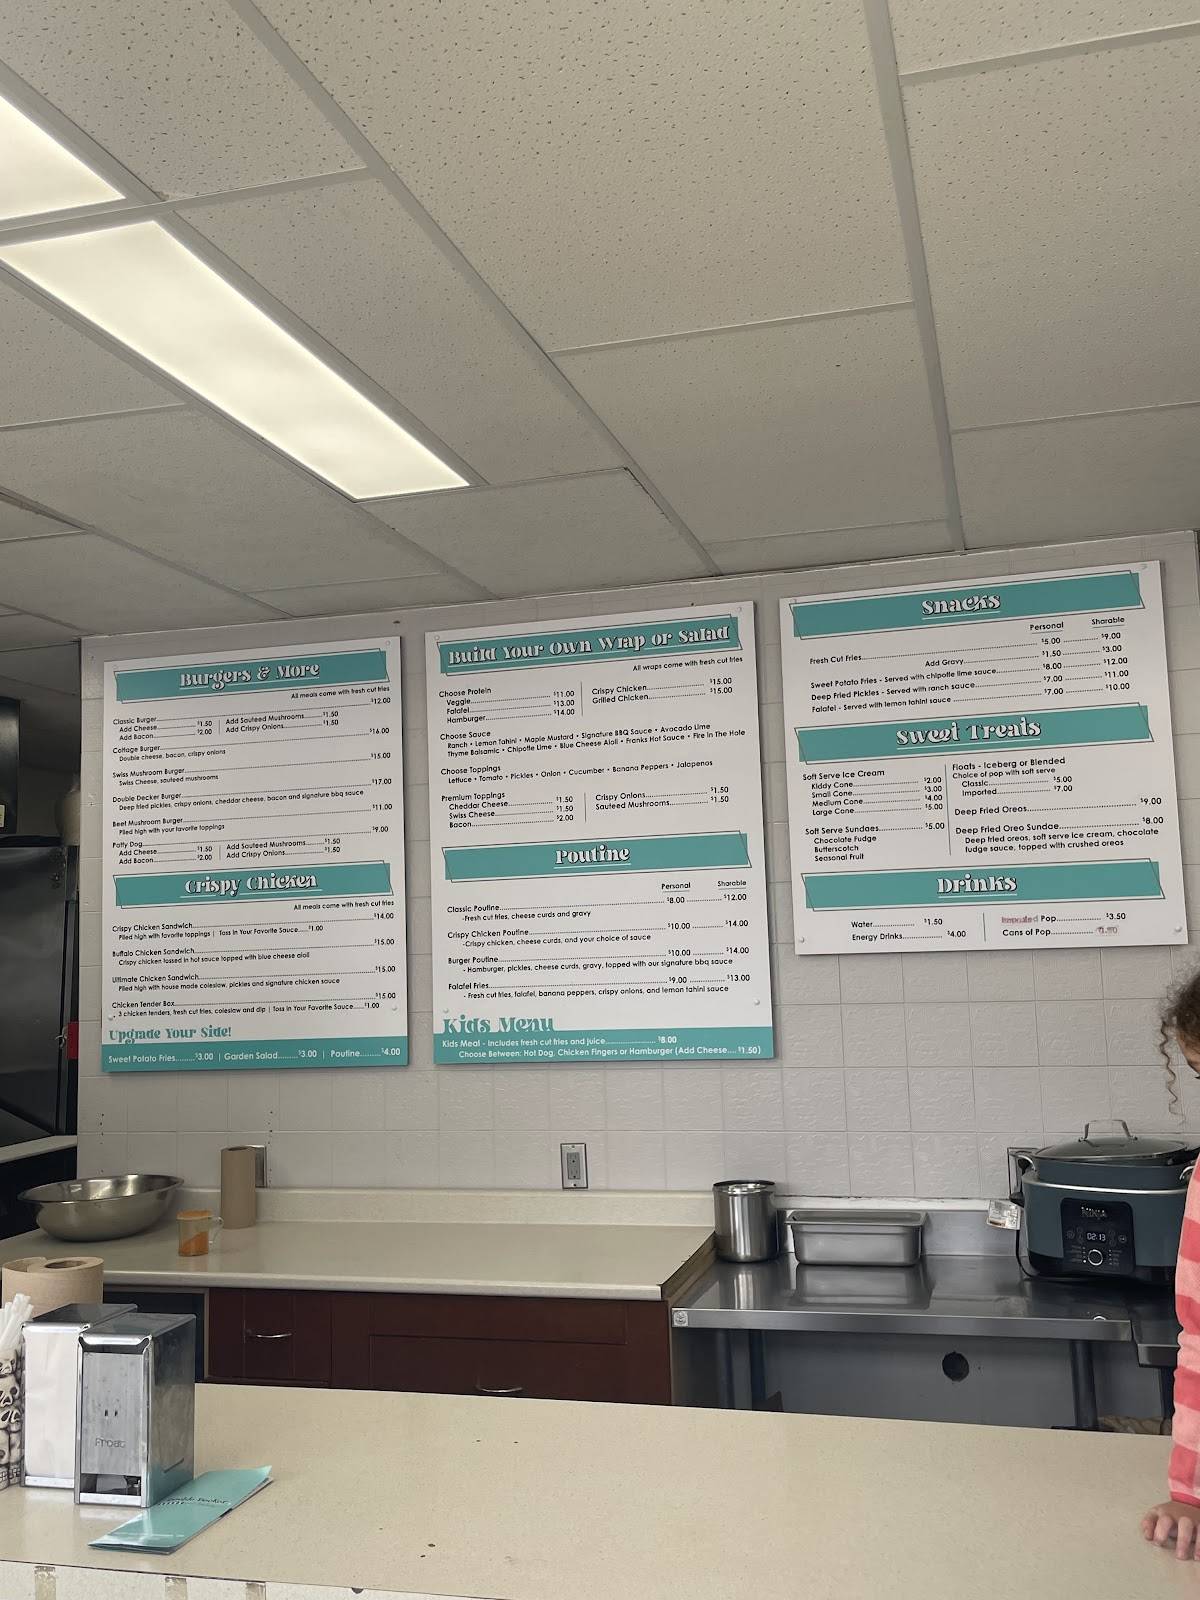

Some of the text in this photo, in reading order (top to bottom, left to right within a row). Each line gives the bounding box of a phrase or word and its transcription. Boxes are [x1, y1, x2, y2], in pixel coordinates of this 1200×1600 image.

[922, 595, 1000, 615] Snacks
[1029, 616, 1125, 630] Personal Sharable
[449, 626, 729, 665] Build Your Own Wrap or Salad
[830, 655, 843, 663] Cut
[925, 659, 940, 667] Add
[180, 664, 320, 690] Burgers & More
[810, 680, 833, 689] Sweet
[834, 679, 859, 687] Potato
[438, 687, 491, 698] Choose Protein
[591, 687, 614, 695] Crispy
[616, 685, 646, 693] Chicken
[833, 691, 851, 699] Fried
[853, 689, 879, 697] Pickles
[446, 697, 471, 706] Veggie
[592, 693, 616, 704] Grilled
[617, 693, 648, 702] Chicken
[446, 704, 469, 714] Falafel
[812, 704, 836, 712] Falafel
[446, 715, 486, 723] Hamburger
[896, 716, 1041, 745] Sweet Treats
[952, 762, 975, 771] Floats
[983, 761, 1017, 772] Iceberg
[1030, 756, 1065, 766] Blended
[802, 773, 817, 781] Soft
[818, 772, 840, 780] Serve
[811, 782, 831, 793] Kiddy
[961, 779, 988, 787] Classic
[595, 793, 618, 801] Crispy
[811, 788, 831, 798] Small
[962, 788, 997, 797] Imported
[448, 802, 480, 810] Cheddar
[481, 799, 508, 808] Cheese
[812, 799, 842, 807] Medium
[954, 808, 977, 816] Deep
[979, 806, 999, 814] Fried
[1002, 805, 1029, 813] Oreos
[805, 827, 819, 835] Soft
[845, 825, 879, 833] Sundaes
[955, 827, 978, 835] Deep
[980, 825, 1000, 833] Fried
[1003, 824, 1024, 832] Oreo
[1026, 822, 1059, 831] Sundae
[555, 844, 630, 864] Poutine
[184, 872, 318, 896] Crispy Chicken
[661, 879, 746, 890] Personal Sharable
[938, 873, 1017, 893] Drinks
[446, 905, 471, 913] Classic
[1040, 915, 1056, 923] Pop
[447, 931, 469, 939] Crispy
[502, 928, 529, 936] Poutine
[852, 933, 878, 942] Energy
[879, 932, 902, 940] Drinks
[1025, 928, 1033, 936] of
[1035, 928, 1051, 936] Pop
[448, 982, 471, 990] Falafel
[443, 1014, 553, 1034] Kids Menu
[109, 1025, 232, 1044] Upgrade Your Side!
